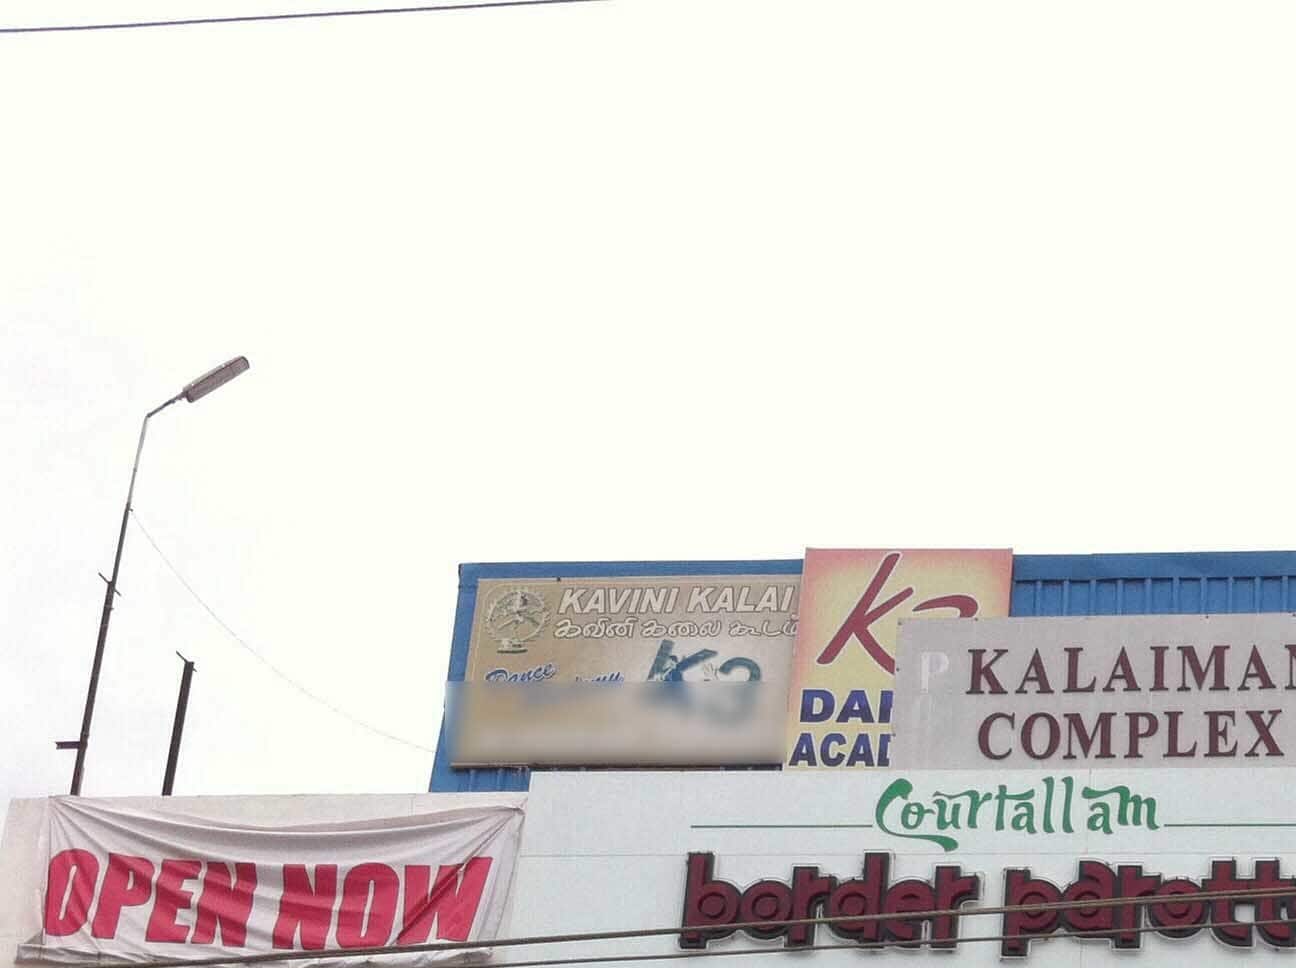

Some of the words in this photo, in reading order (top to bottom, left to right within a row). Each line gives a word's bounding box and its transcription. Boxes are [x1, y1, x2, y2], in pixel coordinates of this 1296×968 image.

[557, 587, 679, 615] KAVINI
[686, 585, 796, 613] KALAI
[816, 553, 979, 676] K
[977, 709, 1285, 761] COMPLEX
[44, 848, 257, 948] OPEN
[271, 856, 494, 951] NOW
[680, 851, 982, 951] border
